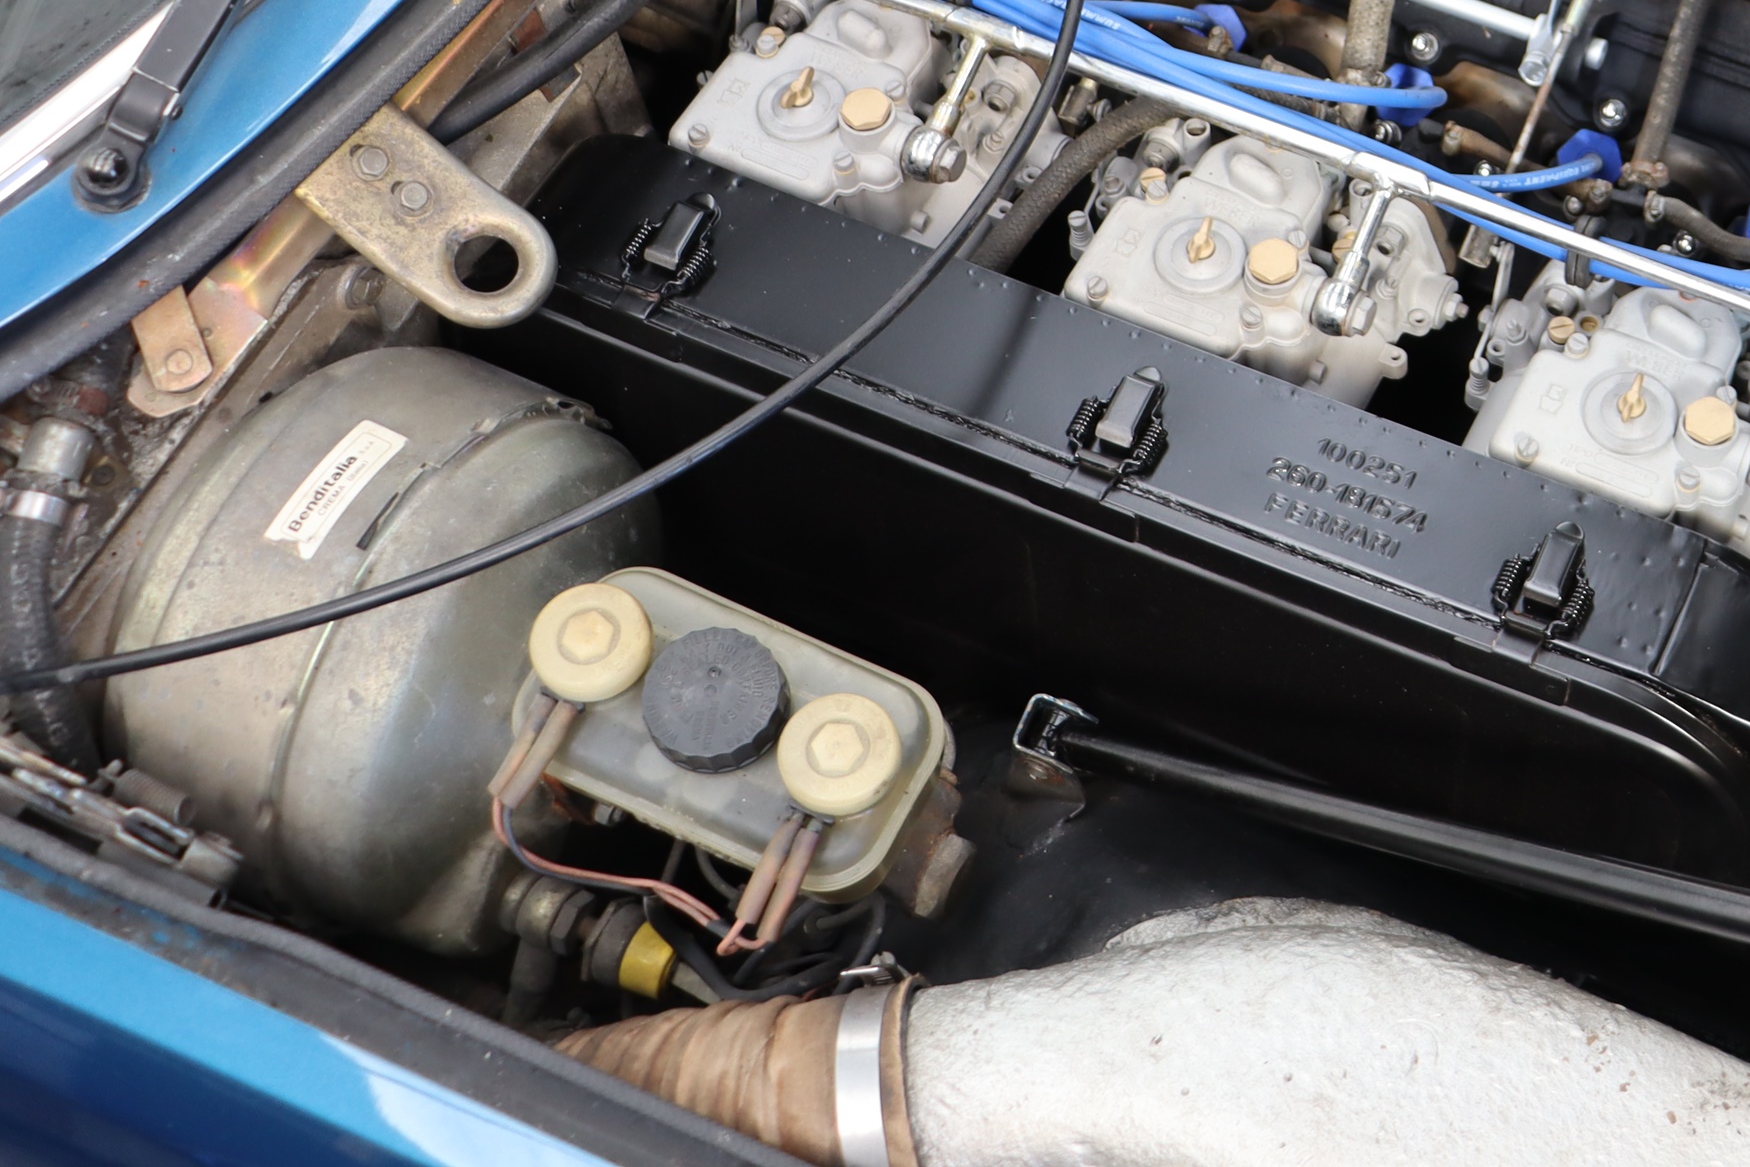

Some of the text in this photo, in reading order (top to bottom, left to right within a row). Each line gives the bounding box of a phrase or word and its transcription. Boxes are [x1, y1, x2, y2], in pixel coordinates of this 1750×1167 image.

[1317, 437, 1418, 489] 100251
[287, 455, 357, 533] Benditalia
[317, 484, 346, 516] CREMA
[1264, 492, 1401, 560] FERRARI
